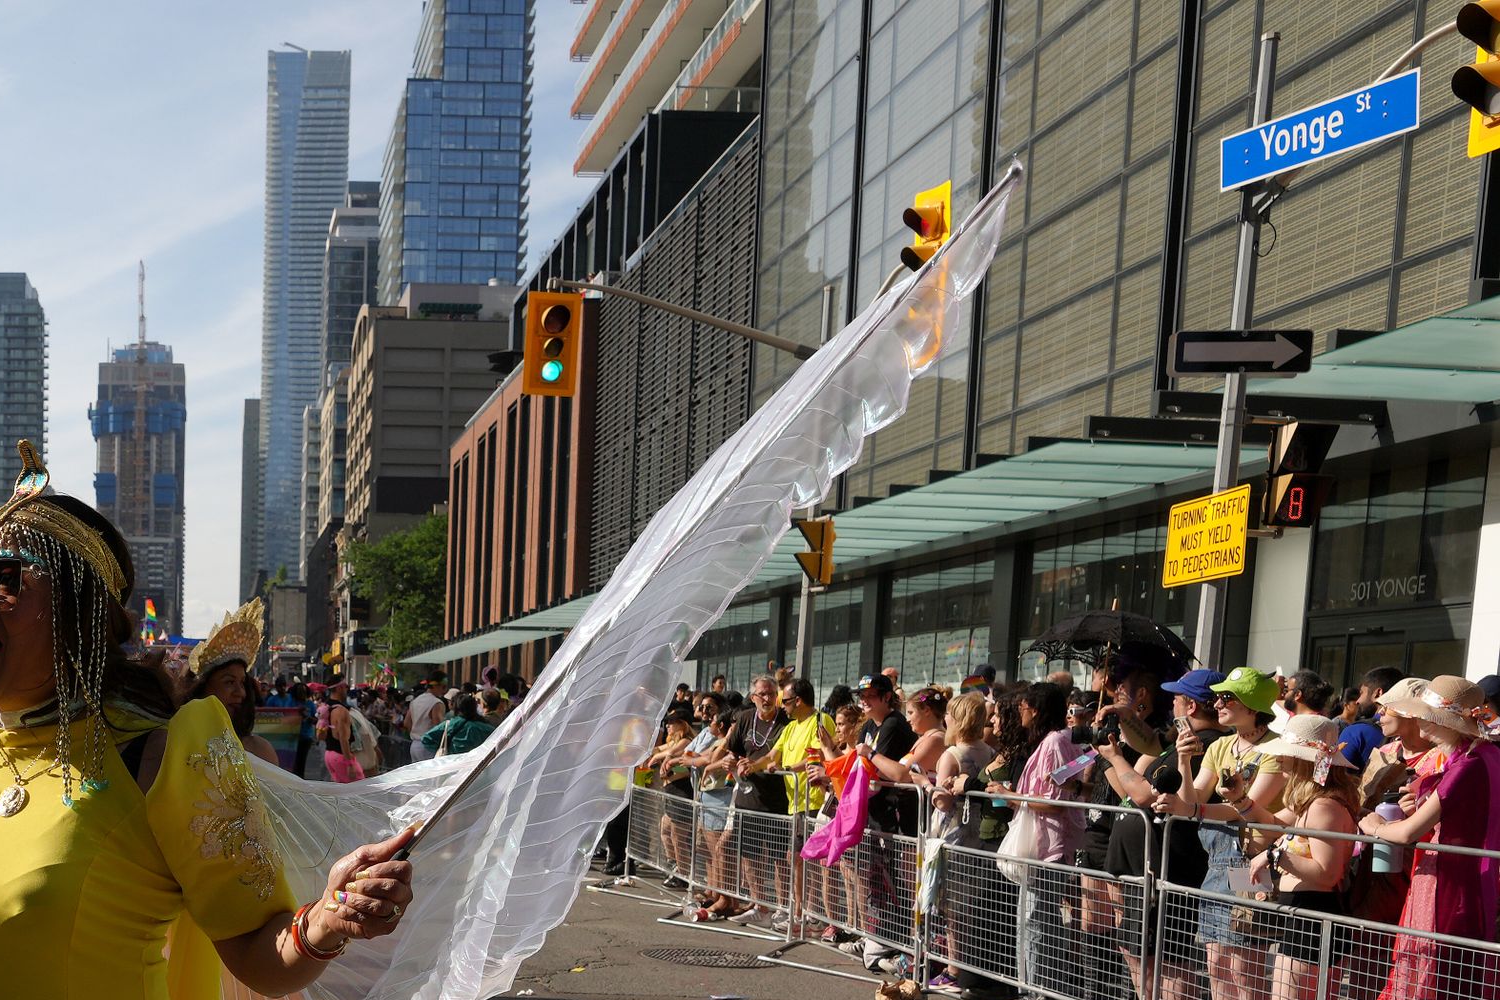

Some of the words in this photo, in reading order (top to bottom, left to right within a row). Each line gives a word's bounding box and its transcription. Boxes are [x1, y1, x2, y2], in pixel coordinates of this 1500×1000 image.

[1259, 109, 1344, 161] Yonge
[1355, 92, 1371, 113] St
[1173, 504, 1208, 531] TURNING
[1211, 495, 1246, 520] TRAFFIC
[1288, 487, 1304, 520] 8
[1180, 530, 1204, 553] MUST
[1208, 524, 1232, 547] YIELD
[1168, 560, 1179, 578] TO
[1182, 546, 1241, 575] PEDESTRIANS
[1350, 582, 1371, 601] 501
[1375, 575, 1427, 598] YONGE
